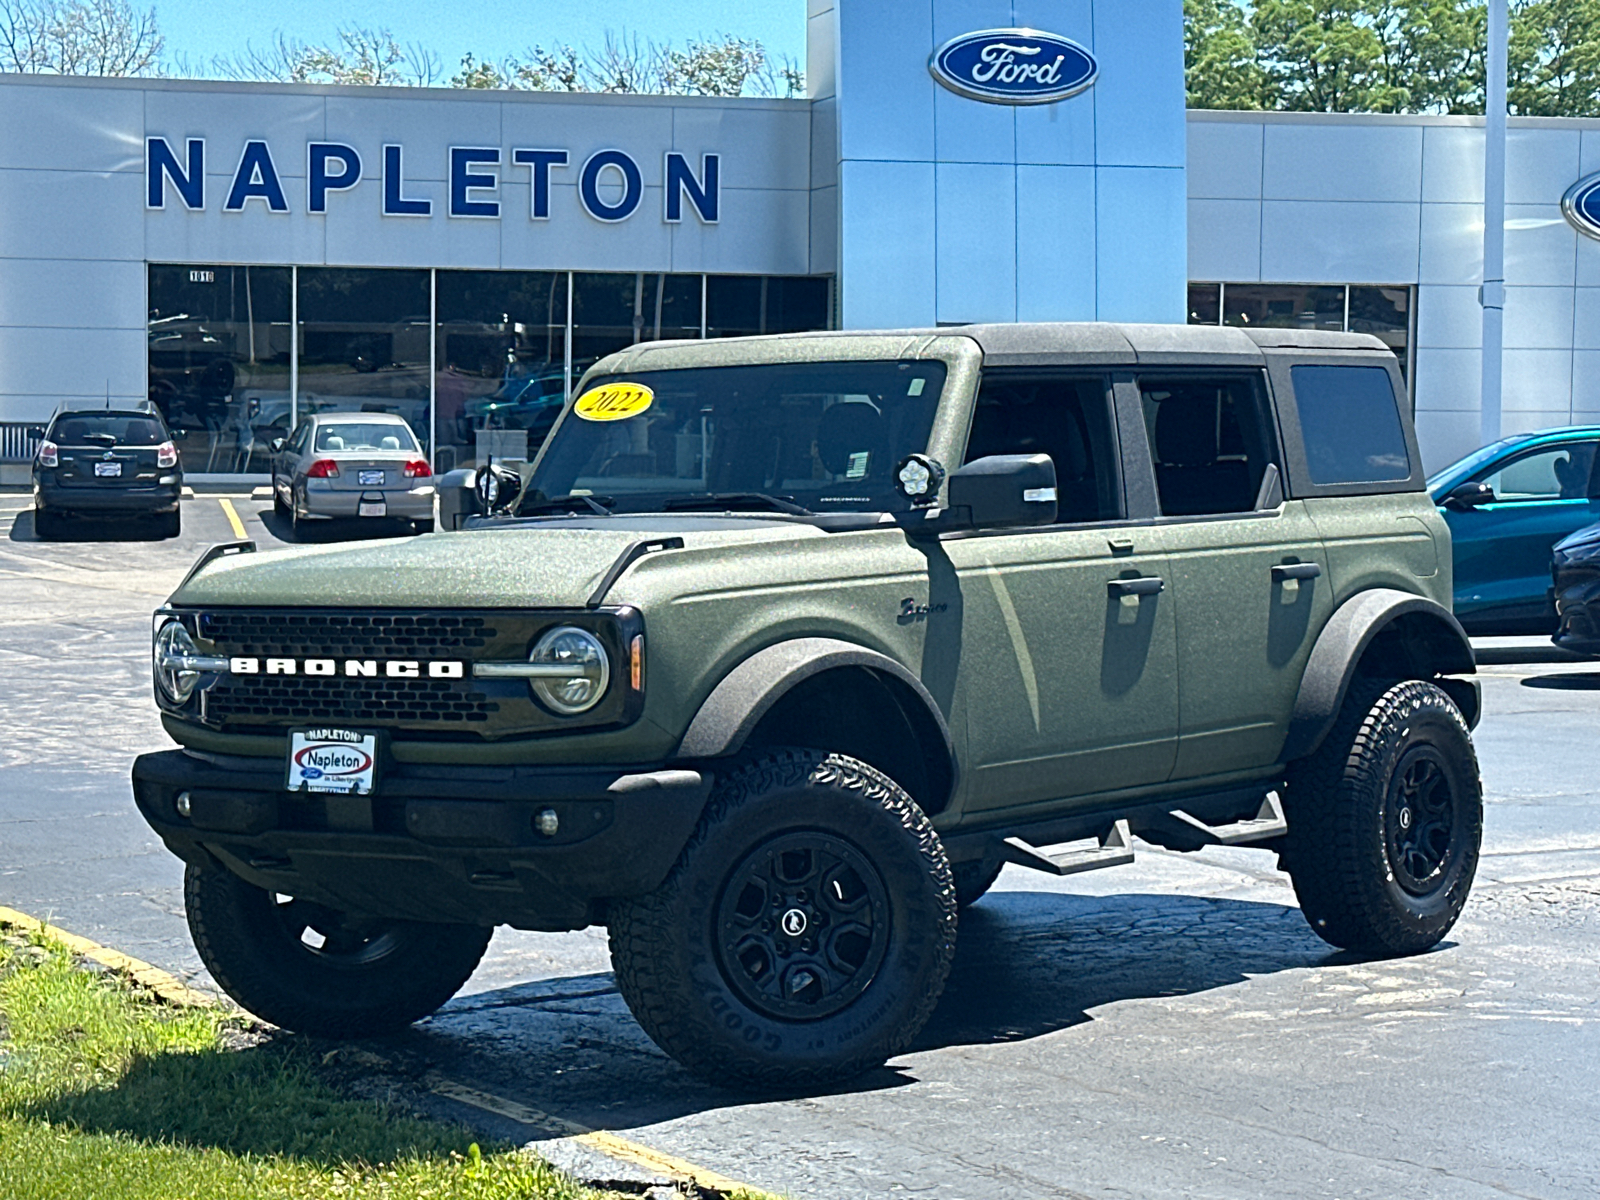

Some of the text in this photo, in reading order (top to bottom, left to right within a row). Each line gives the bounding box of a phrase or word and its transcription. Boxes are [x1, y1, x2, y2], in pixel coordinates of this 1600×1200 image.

[972, 43, 1065, 84] Ford
[146, 136, 720, 223] NAPLETON
[583, 391, 643, 412] 2022
[230, 657, 463, 678] BRONCO
[308, 729, 358, 741] NAPLETON
[308, 751, 359, 770] Napleton
